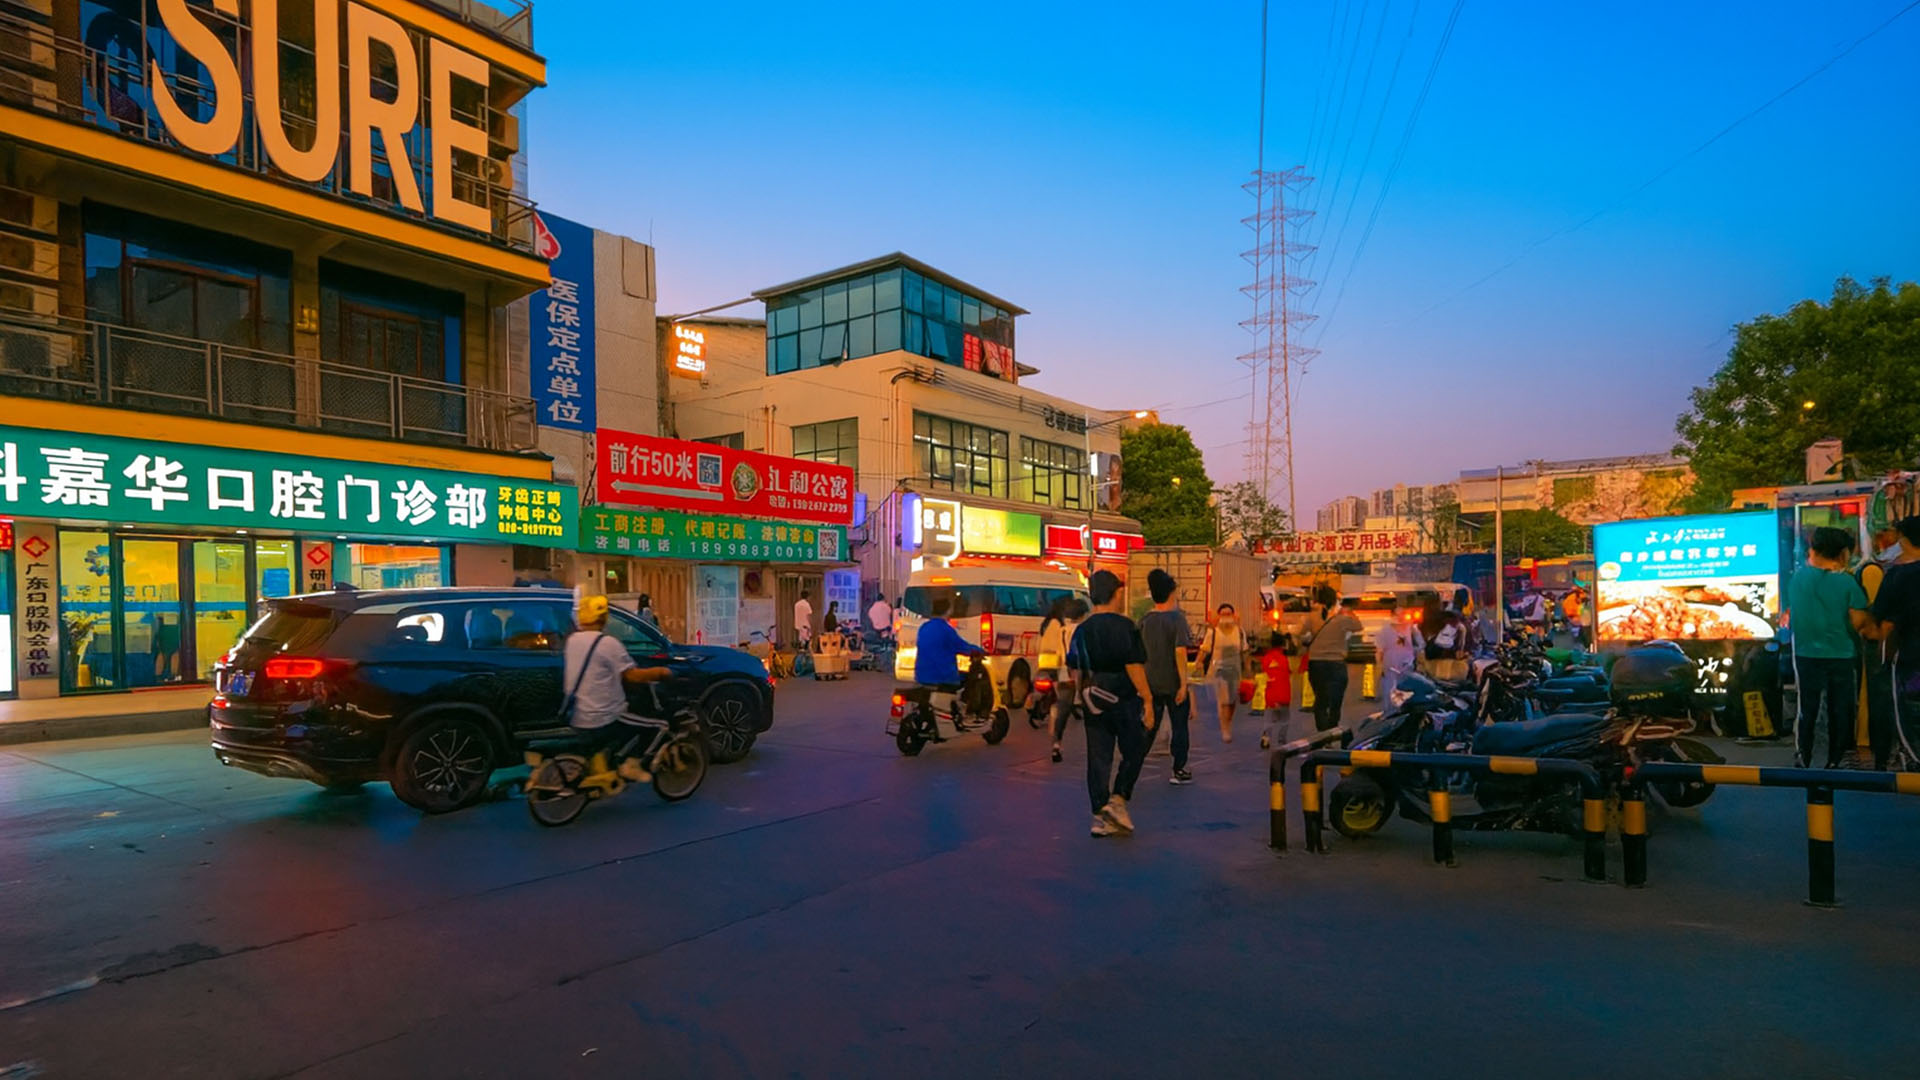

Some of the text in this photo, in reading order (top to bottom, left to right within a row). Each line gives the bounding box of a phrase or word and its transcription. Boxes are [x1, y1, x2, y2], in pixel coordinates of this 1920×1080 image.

[152, 0, 491, 233] SURE
[546, 276, 583, 424] 医保定点单位
[608, 443, 693, 482] 前行50米
[25, 562, 50, 676] 广东口腔协会单位
